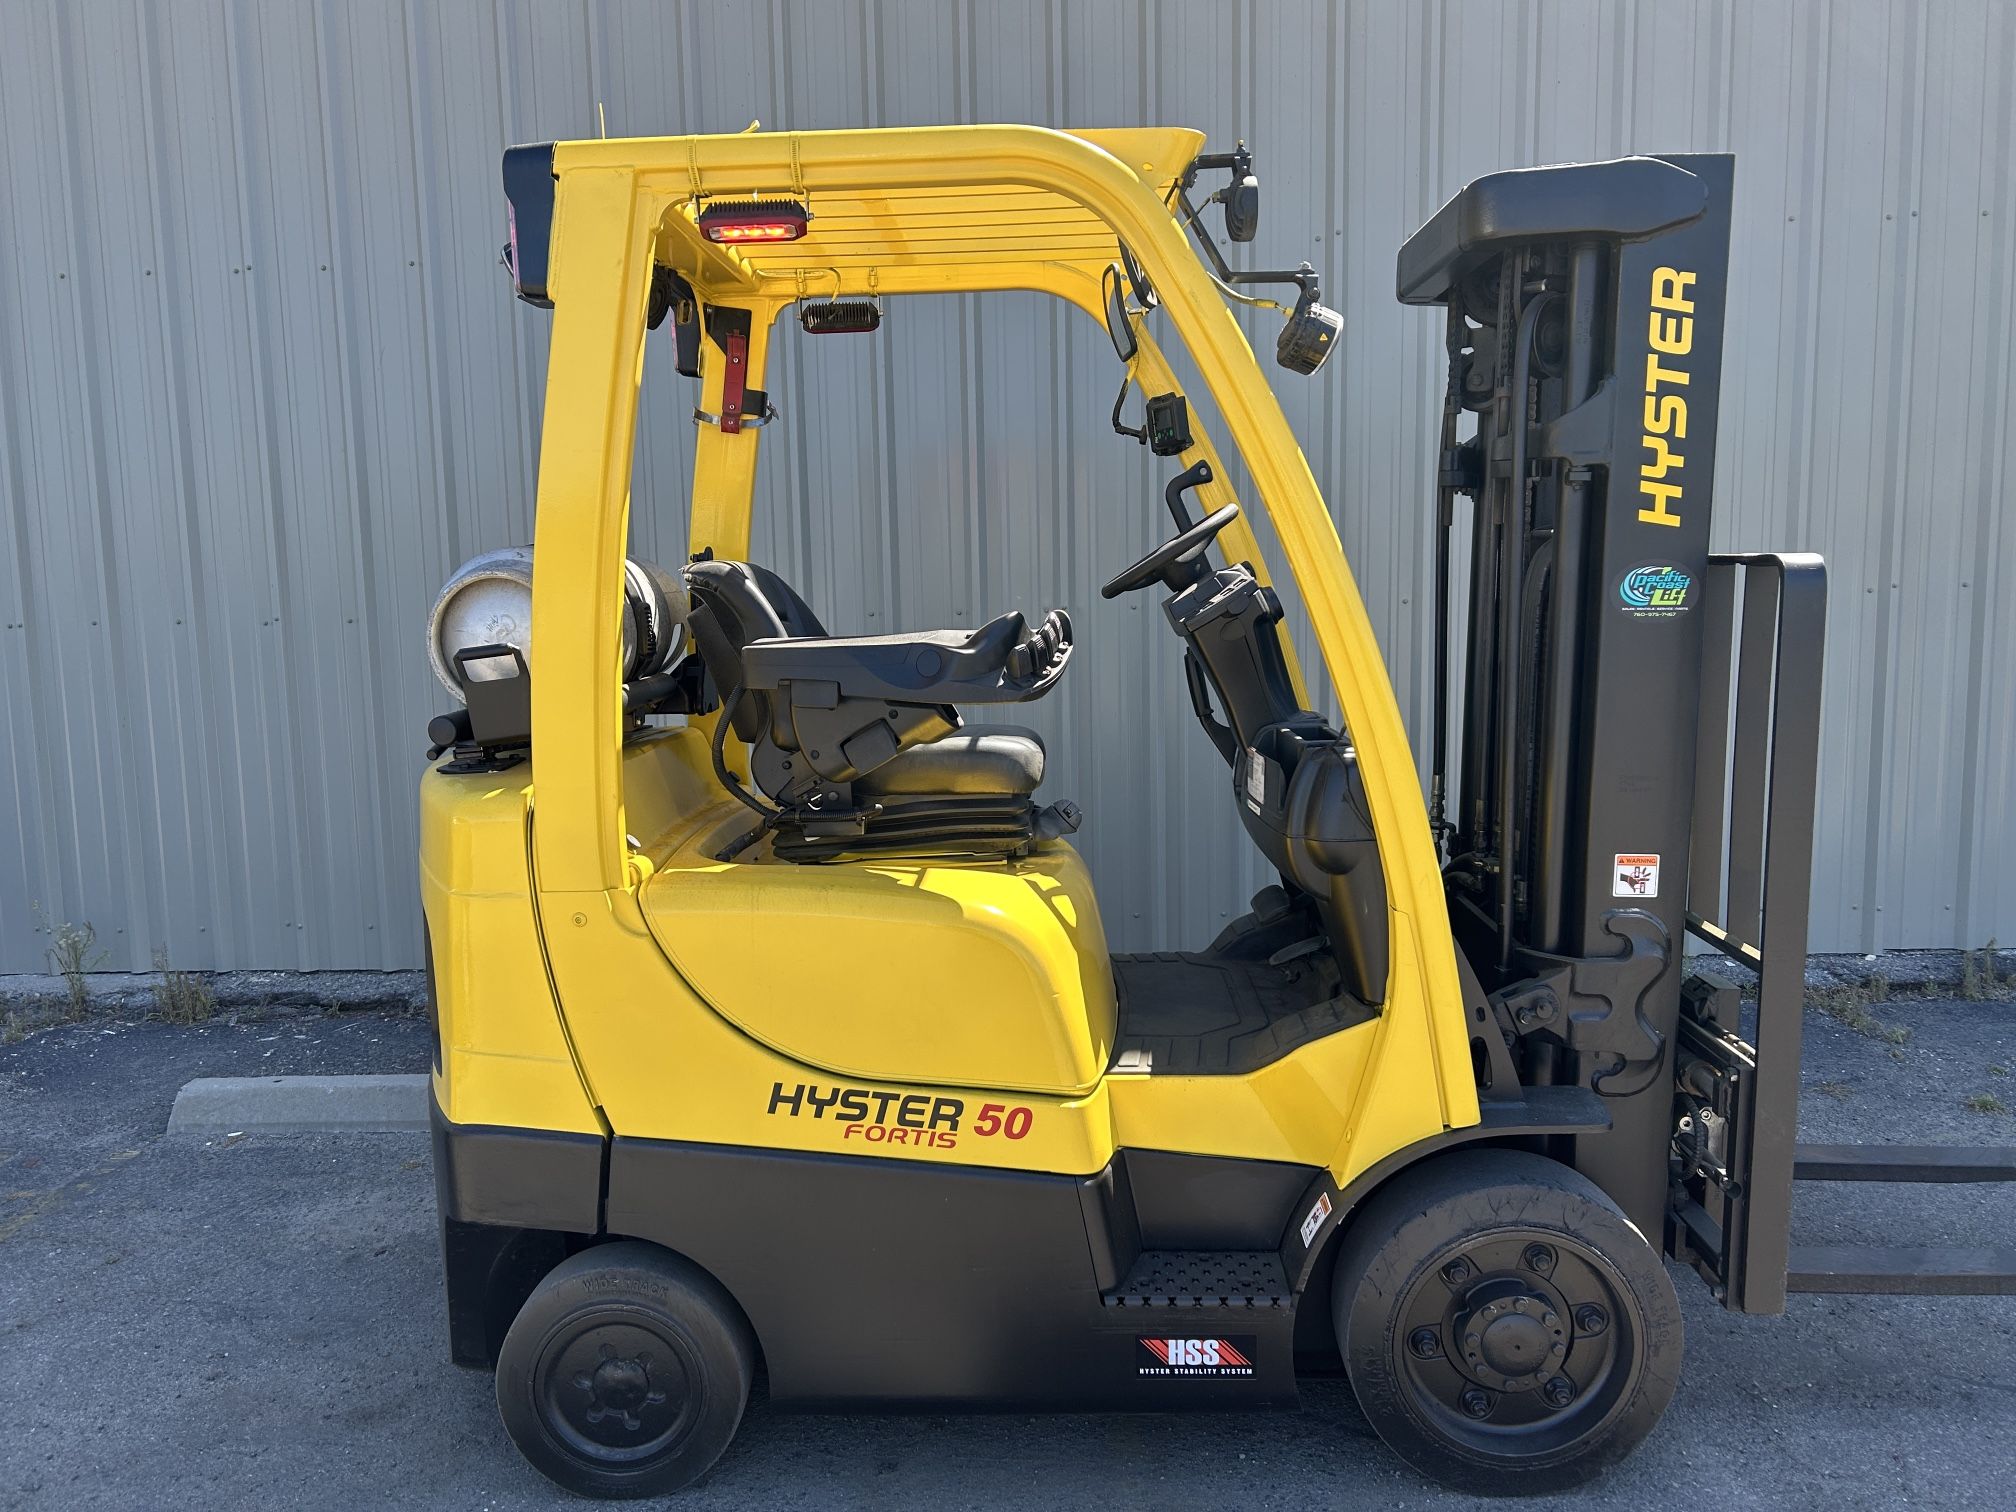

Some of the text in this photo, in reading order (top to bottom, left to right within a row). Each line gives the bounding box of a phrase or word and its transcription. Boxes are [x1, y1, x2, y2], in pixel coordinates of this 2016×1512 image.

[1638, 266, 1696, 527] HYSTER
[1644, 577, 1690, 594] Coast
[1650, 588, 1686, 605] Lift
[767, 1082, 1033, 1140] HYSTER 50
[843, 1123, 958, 1149] FORTIS
[1168, 1339, 1220, 1366] HSS
